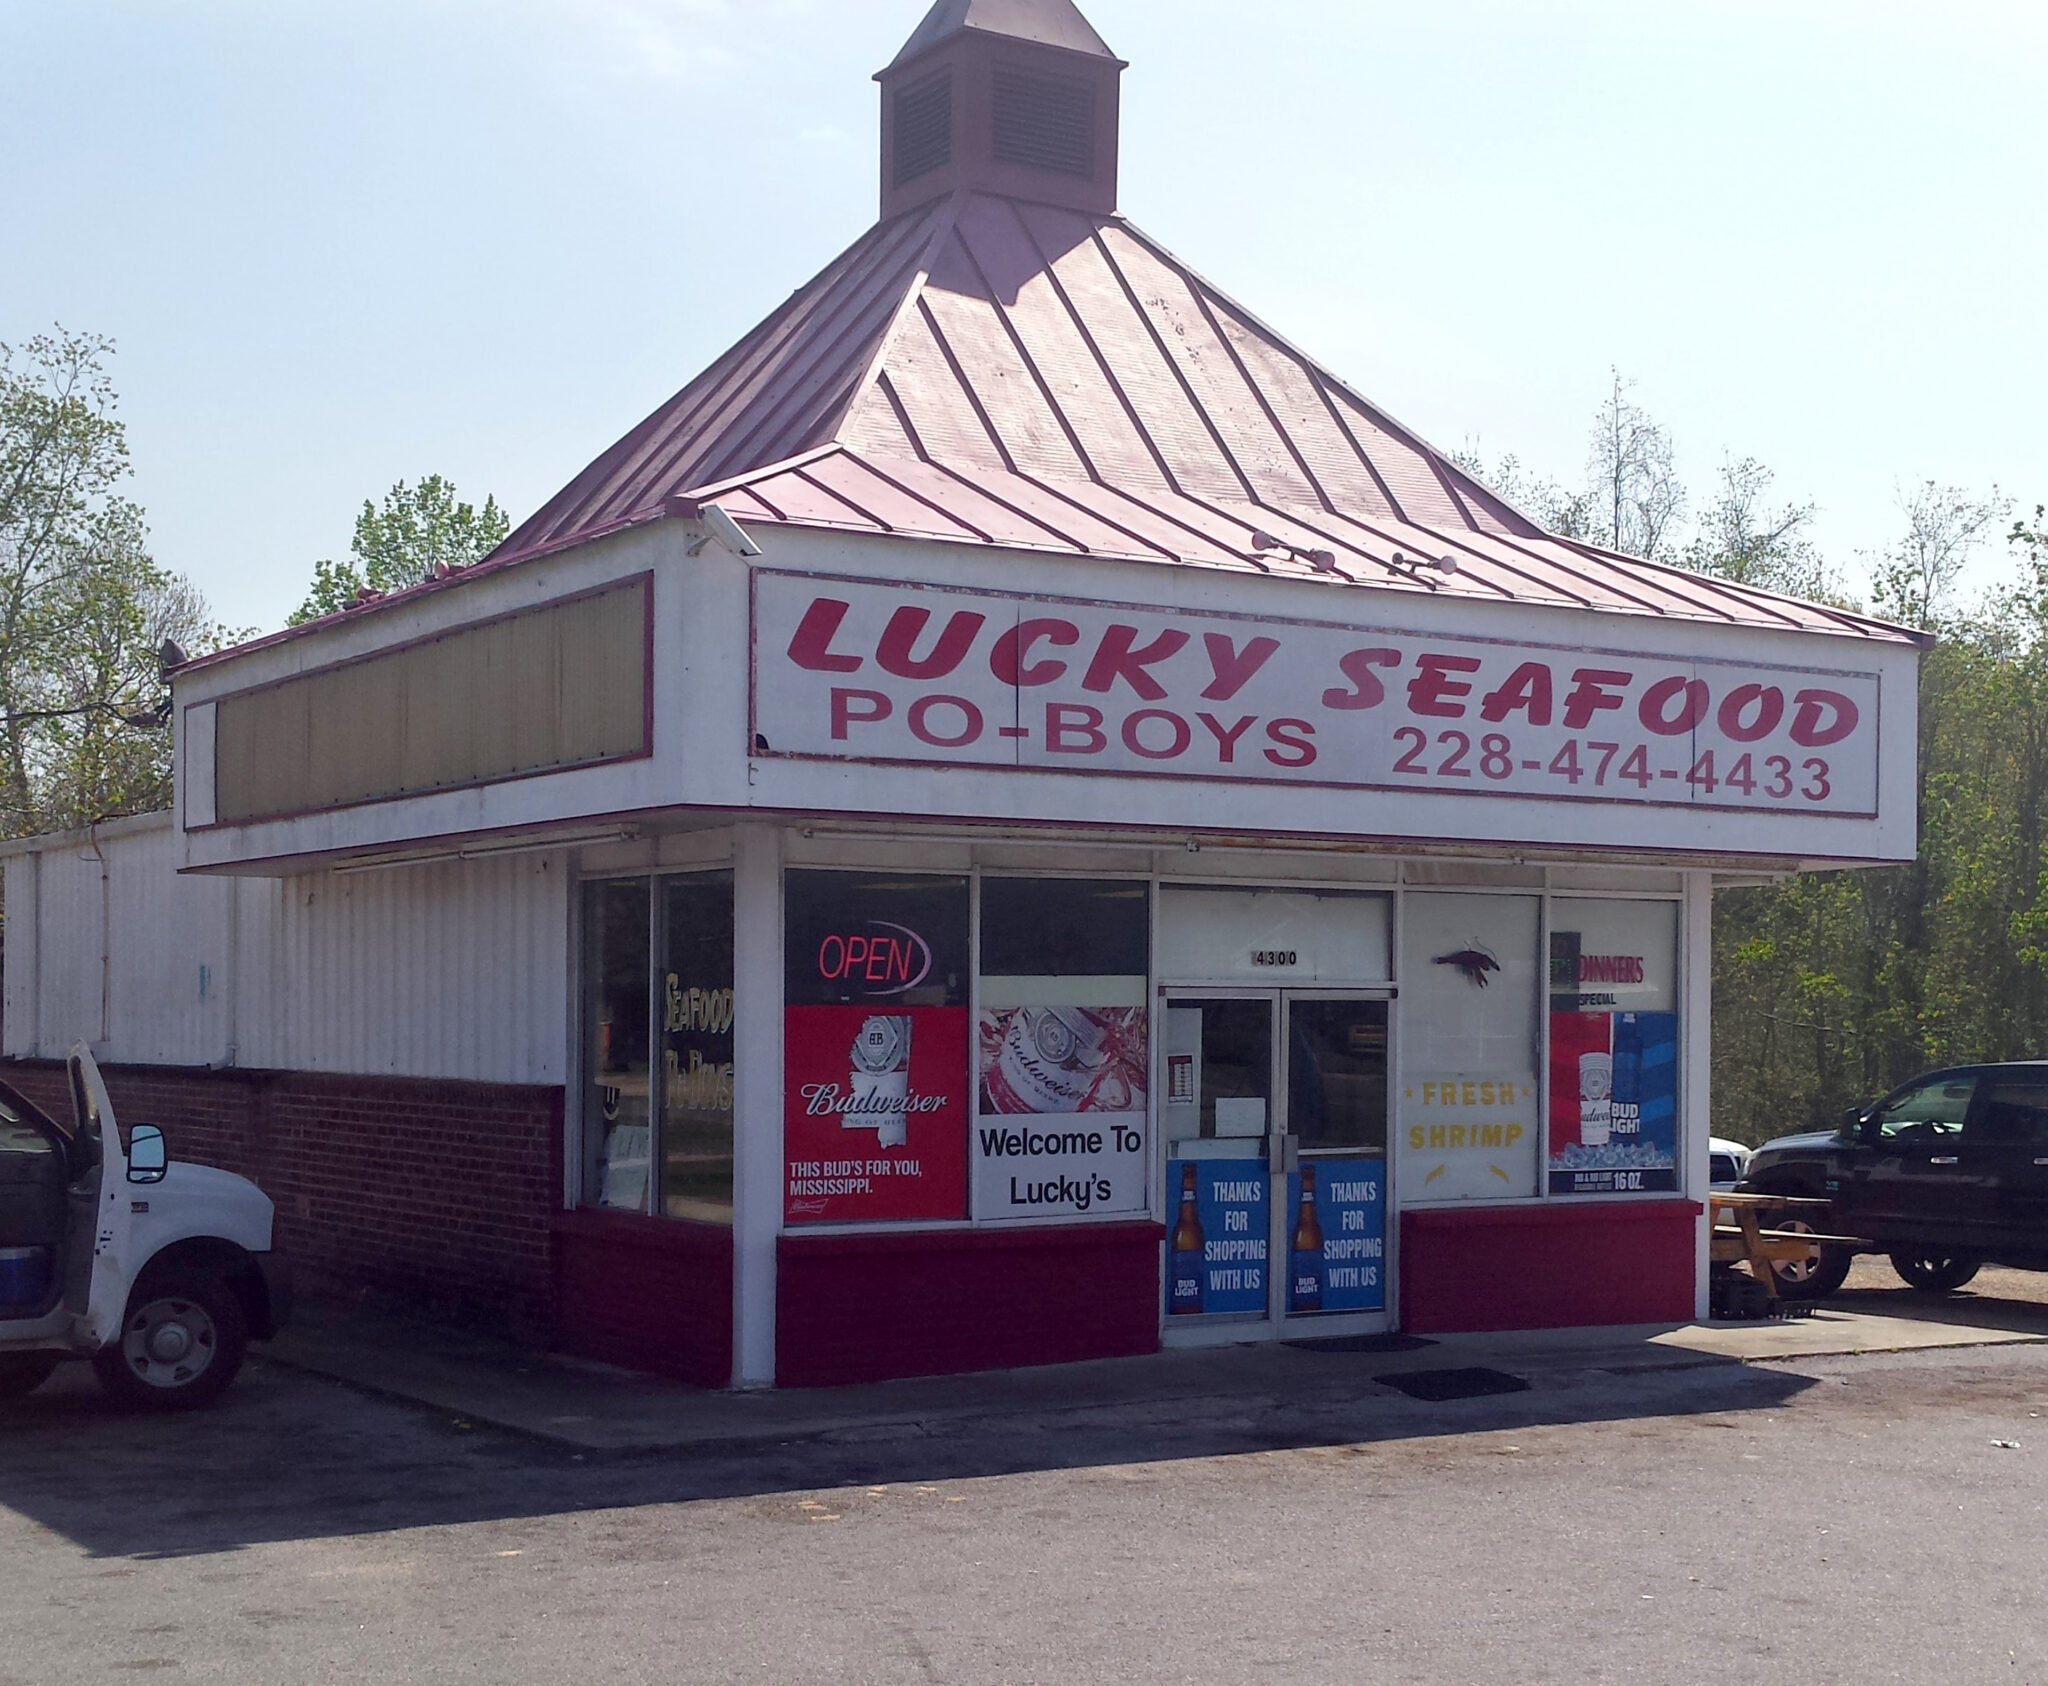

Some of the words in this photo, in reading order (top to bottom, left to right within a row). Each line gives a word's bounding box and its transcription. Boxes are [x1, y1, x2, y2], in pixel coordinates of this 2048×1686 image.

[787, 597, 1281, 701] LUCKY
[1321, 648, 1860, 747] SEAFOOD
[830, 687, 1318, 768] PO-BOYS
[1392, 726, 1832, 801] 228-474-4433
[818, 934, 914, 981] OPEN
[1257, 951, 1297, 965] 4300
[664, 972, 734, 1034] SEAFOOD
[1007, 1025, 1087, 1101] Budweiser
[800, 1083, 948, 1116] Budweiser
[1422, 1082, 1515, 1106] FRESH
[1611, 1102, 1639, 1118] BUD
[979, 1126, 1103, 1157] Welcome
[1110, 1124, 1141, 1153] To
[1408, 1122, 1524, 1150] SHRIMP
[789, 1161, 821, 1178] THIS
[823, 1160, 863, 1177] BUD'S
[865, 1160, 891, 1176] FOR
[894, 1160, 922, 1178] YOU,
[789, 1178, 874, 1196] MISSISSIPPI.
[1010, 1172, 1112, 1210] Lucky's
[1213, 1181, 1262, 1202] THANKS
[1330, 1181, 1377, 1202] THANKS
[1613, 1172, 1627, 1191] 16
[1627, 1172, 1645, 1190] OZ.
[1225, 1210, 1248, 1231] FOR
[1342, 1210, 1365, 1230] FOR
[1204, 1239, 1267, 1261] SHOPPING
[1323, 1238, 1382, 1260] SHOPPING
[1177, 1279, 1196, 1288] BUD
[1209, 1269, 1240, 1290] WITH
[1243, 1269, 1260, 1289] US
[1298, 1277, 1316, 1286] BUD
[1328, 1268, 1358, 1288] WITH
[1360, 1266, 1377, 1286] US
[1174, 1286, 1199, 1297] LIGHT
[1295, 1284, 1319, 1294] LIGHT
